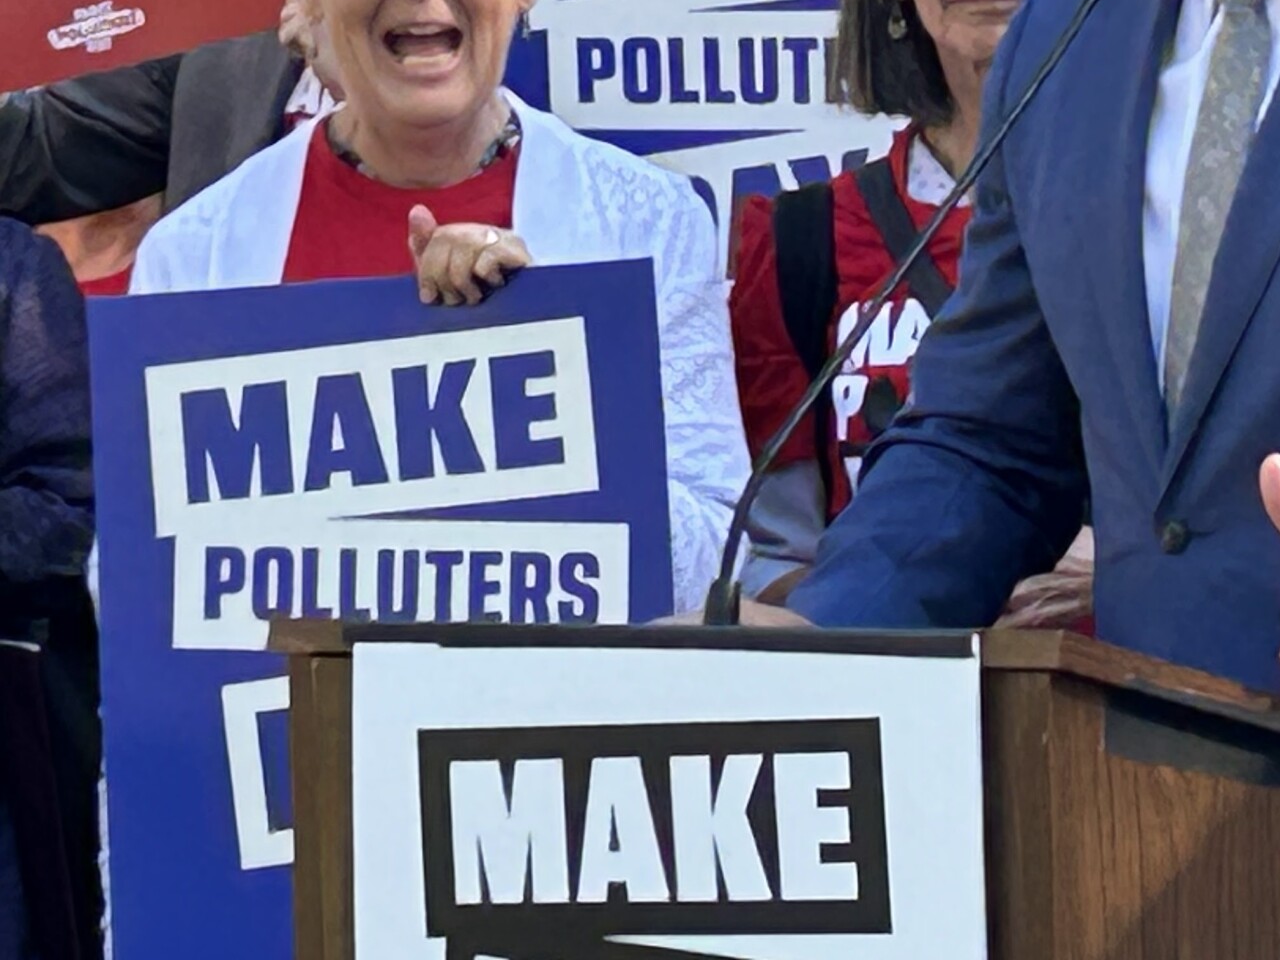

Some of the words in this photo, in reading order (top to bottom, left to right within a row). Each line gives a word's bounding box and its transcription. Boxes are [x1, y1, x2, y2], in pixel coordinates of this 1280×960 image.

[576, 36, 846, 105] POLLUT
[180, 349, 565, 504] MAKE
[203, 545, 601, 624] POLLUTERS
[449, 750, 859, 905] MAKE
